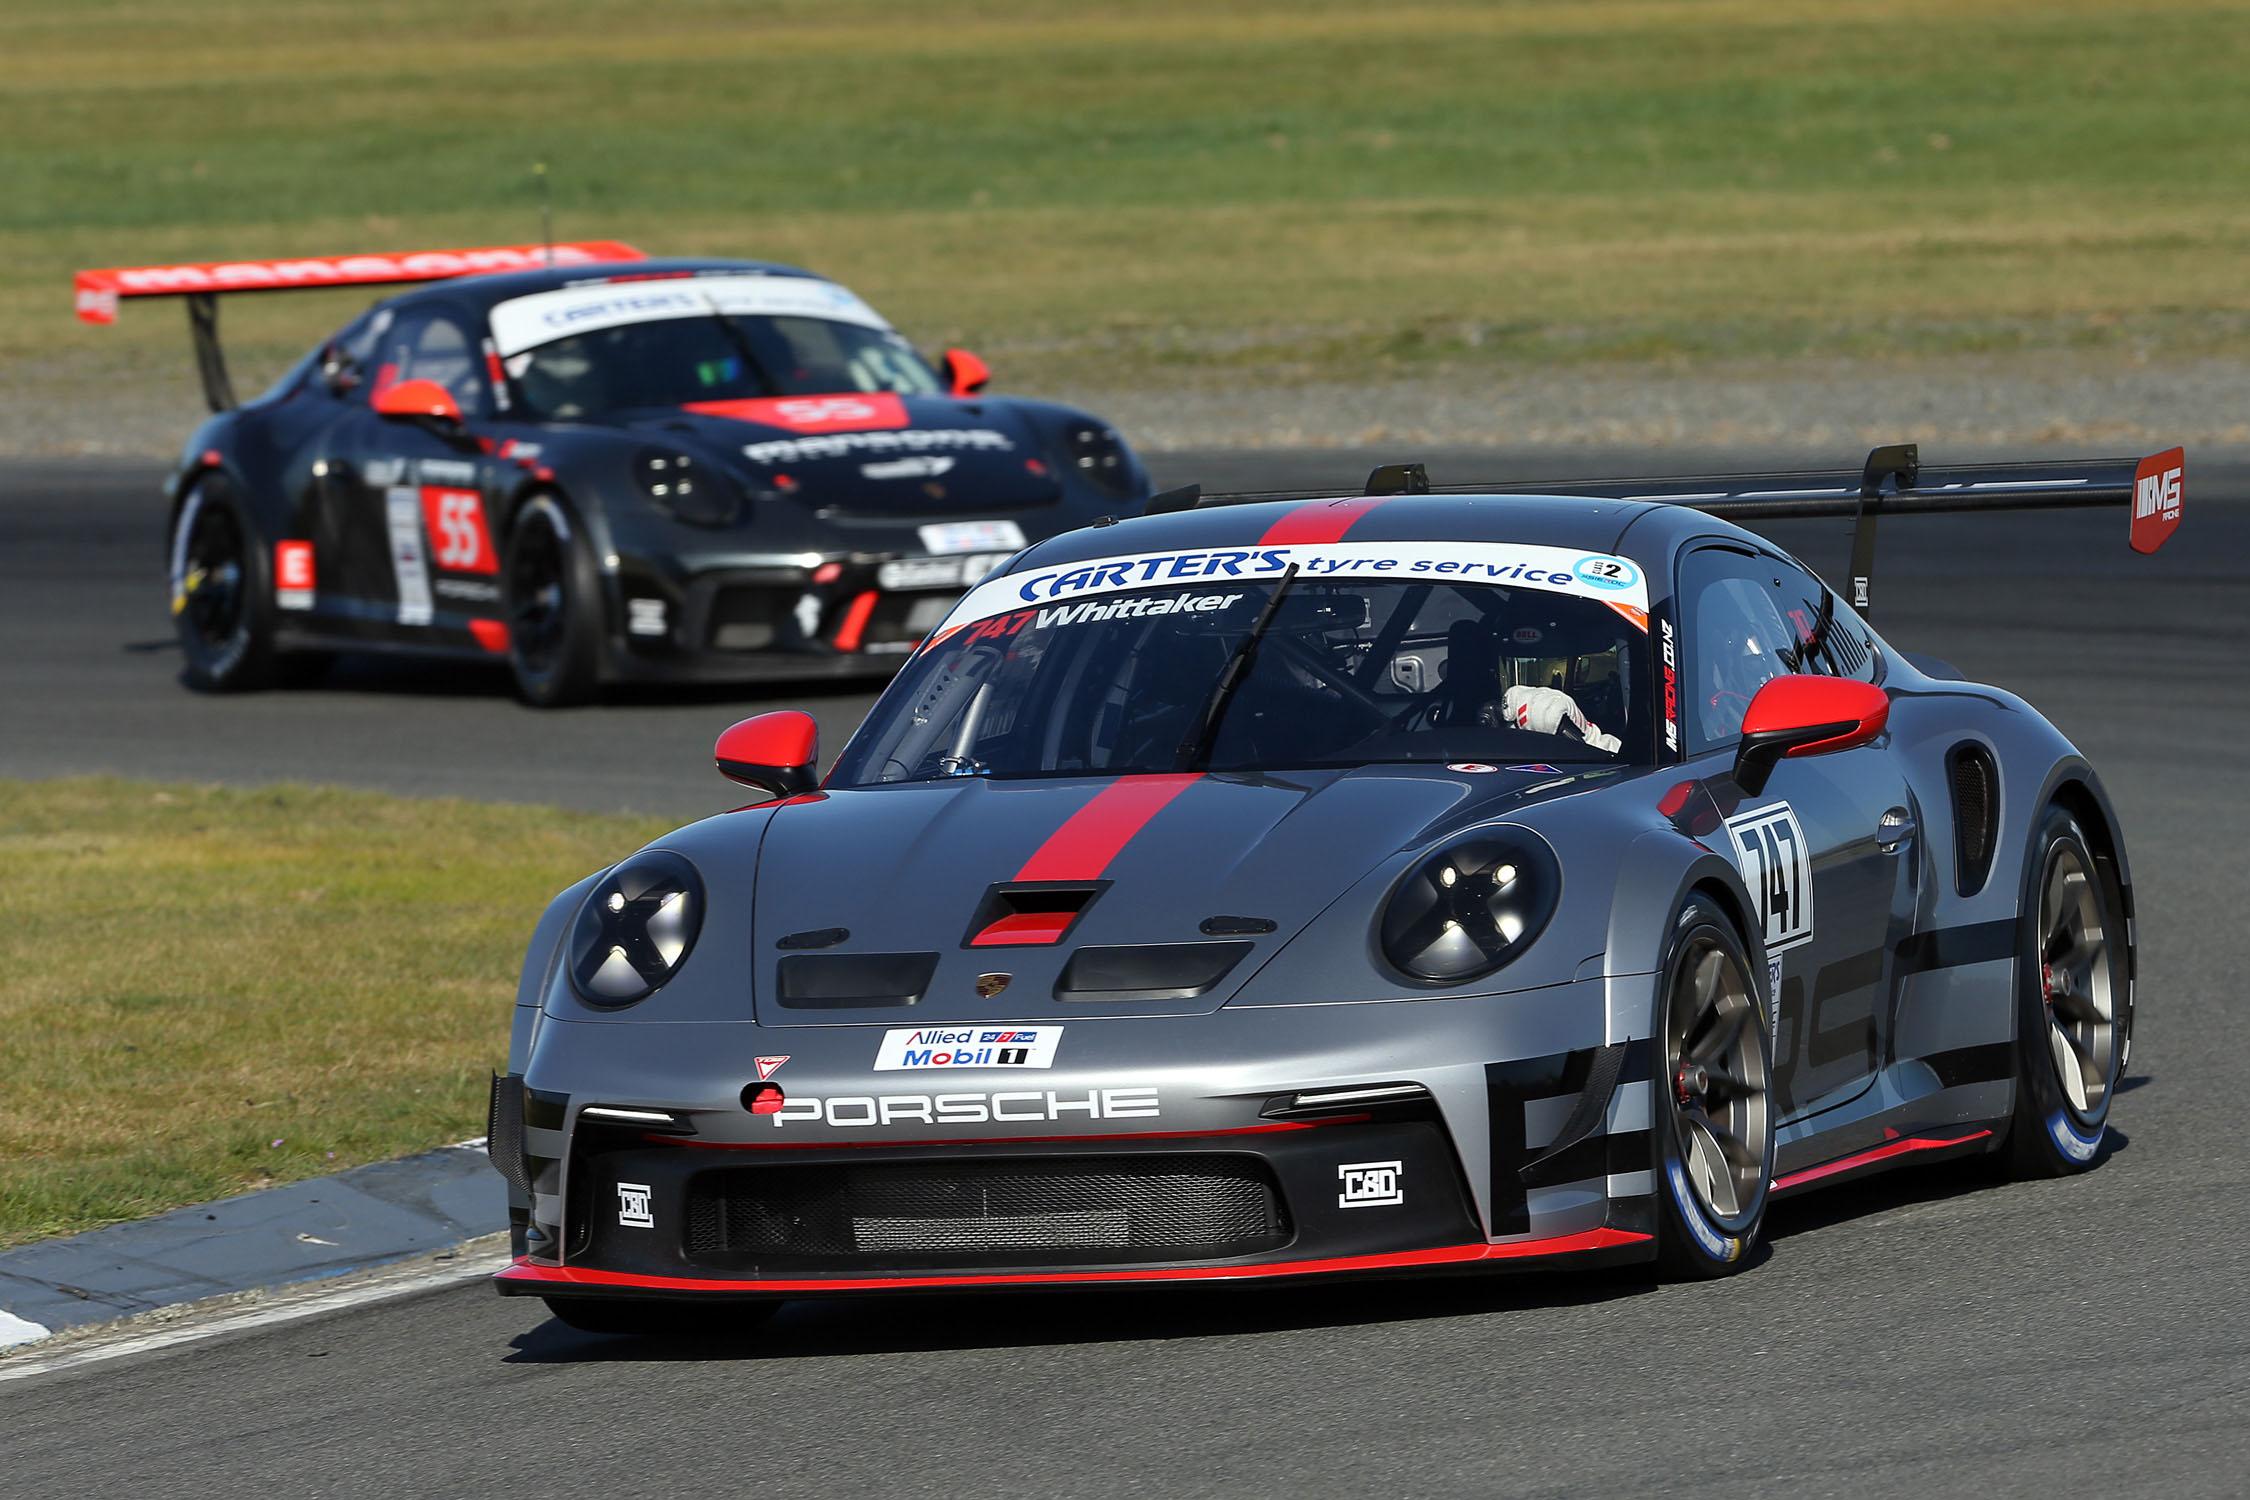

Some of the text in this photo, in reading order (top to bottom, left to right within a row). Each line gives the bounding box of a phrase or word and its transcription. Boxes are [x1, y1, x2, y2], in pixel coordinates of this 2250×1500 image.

[438, 493, 481, 568] 55
[1019, 550, 1291, 602] CARTER'S
[1307, 556, 1398, 574] tyre
[1409, 556, 1574, 586] service
[1603, 563, 1621, 578] 2
[963, 610, 1037, 645] 747
[1035, 593, 1243, 629] Whittaker
[1738, 818, 1800, 939] 747
[902, 1049, 992, 1066] Mobil
[906, 1030, 973, 1045] Allied
[1013, 1033, 1035, 1042] Fuel
[772, 1087, 1161, 1128] PORSCHE
